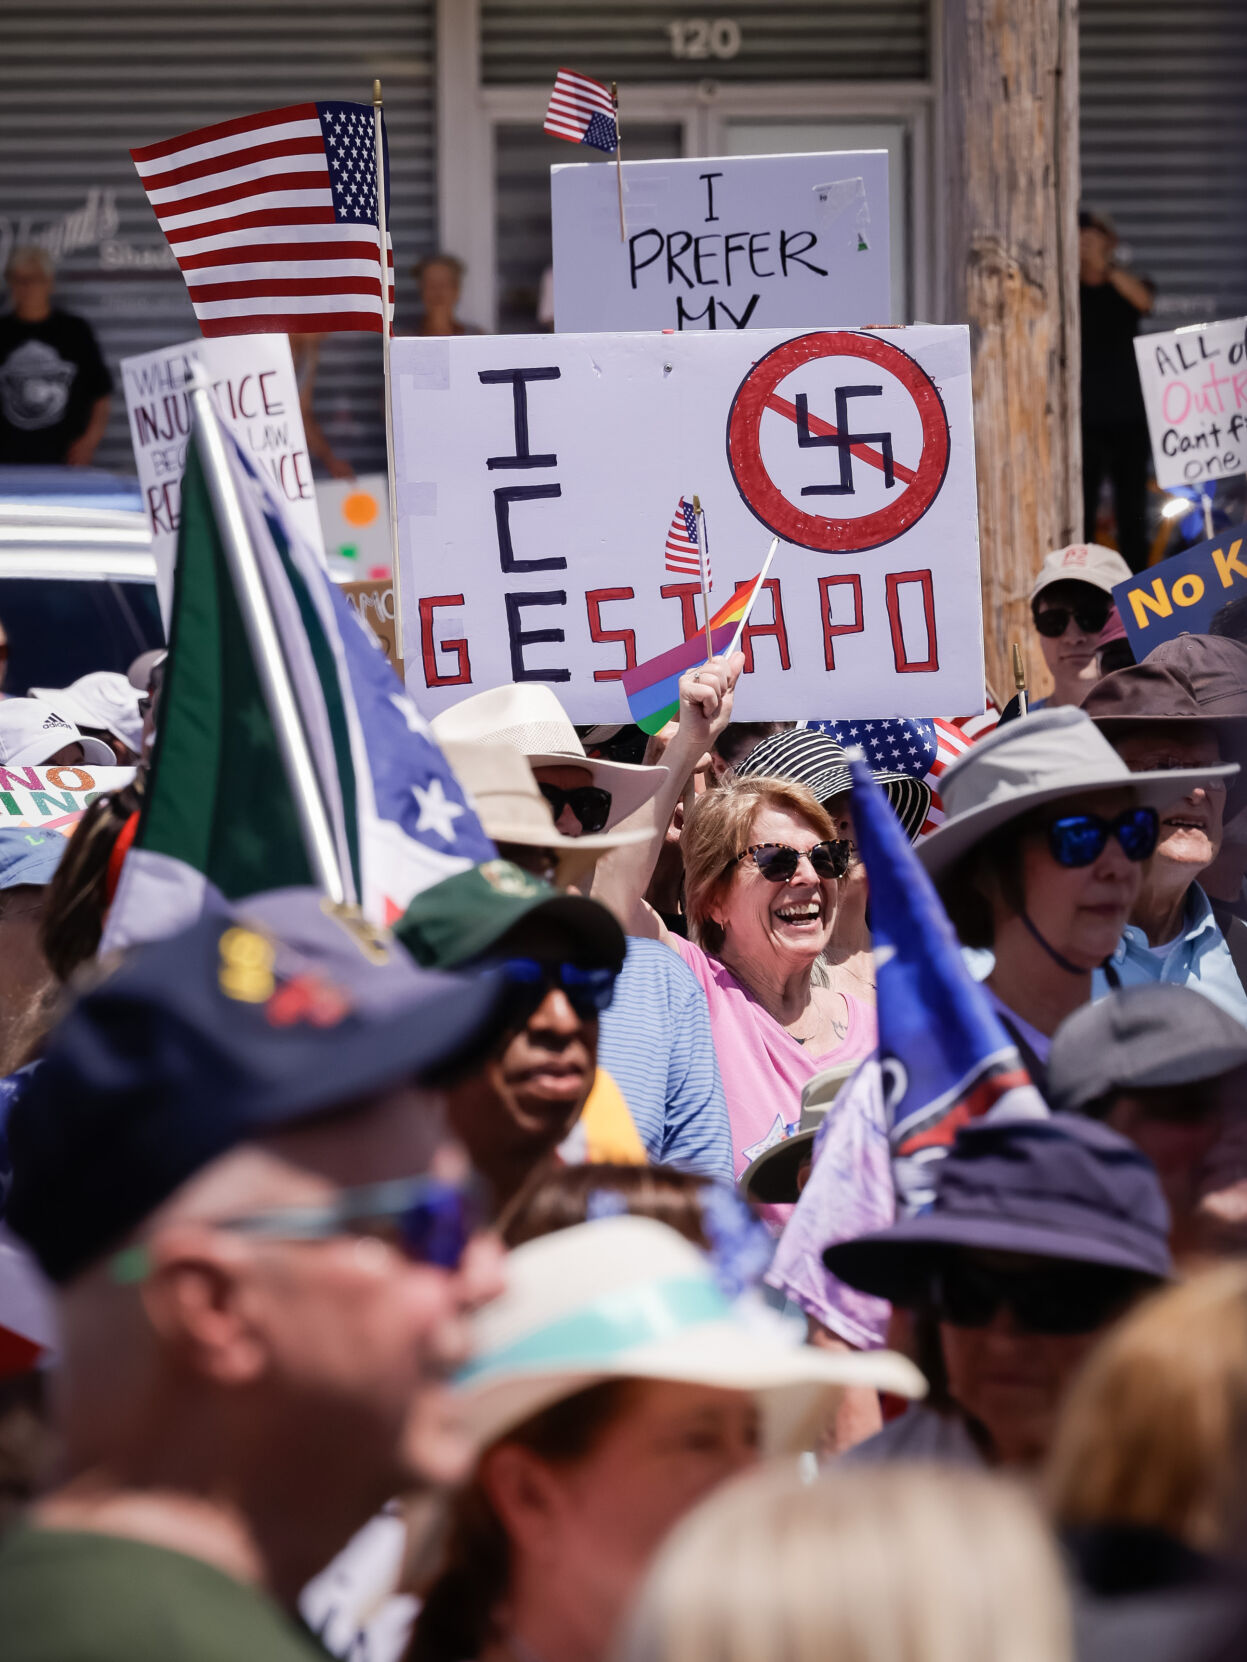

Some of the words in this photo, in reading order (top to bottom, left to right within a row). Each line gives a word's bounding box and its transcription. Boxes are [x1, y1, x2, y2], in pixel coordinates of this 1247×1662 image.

[669, 18, 741, 59] 120
[699, 173, 723, 222] I
[629, 228, 828, 289] PREFER
[1156, 336, 1221, 376] ALL
[1184, 451, 1240, 480] one
[1127, 574, 1205, 630] No
[418, 569, 940, 688] GESTAPO
[0, 767, 96, 791] NO
